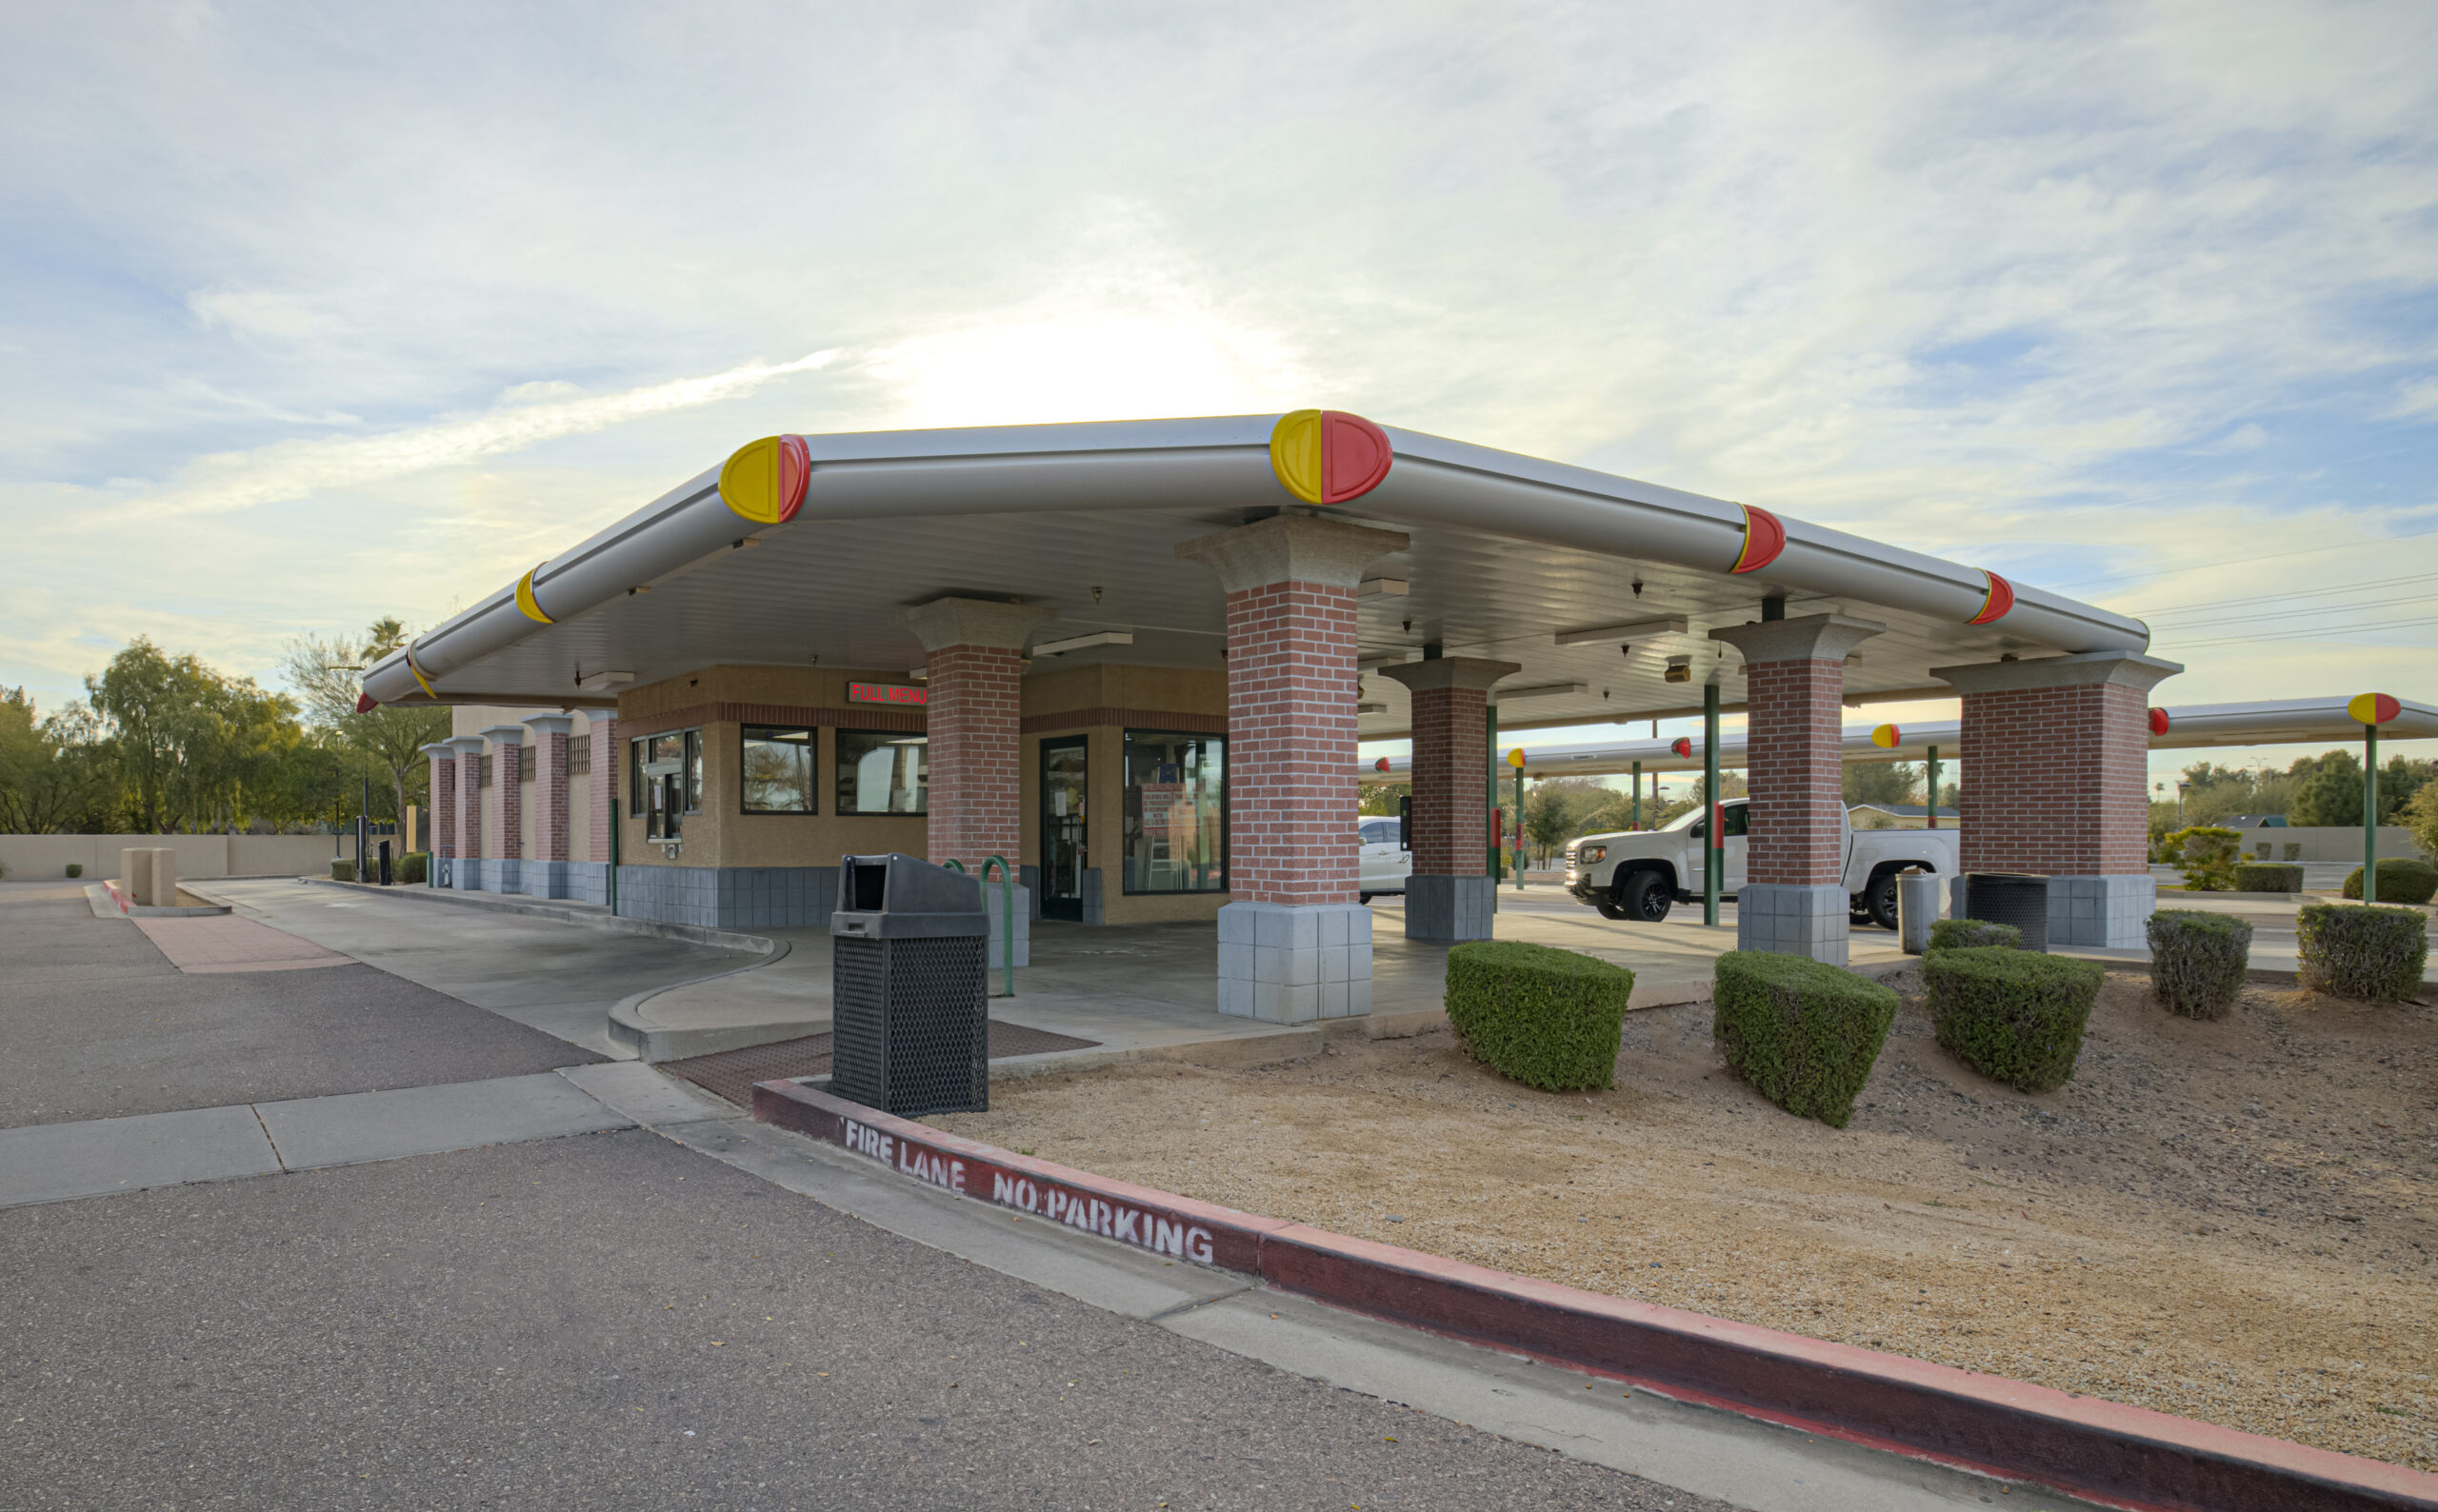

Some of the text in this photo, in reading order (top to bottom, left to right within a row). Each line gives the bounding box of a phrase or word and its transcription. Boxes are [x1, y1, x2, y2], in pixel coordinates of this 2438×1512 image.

[851, 684, 928, 705] FULL MENU
[846, 1119, 1213, 1263] FIRE LANE NO PARKING
